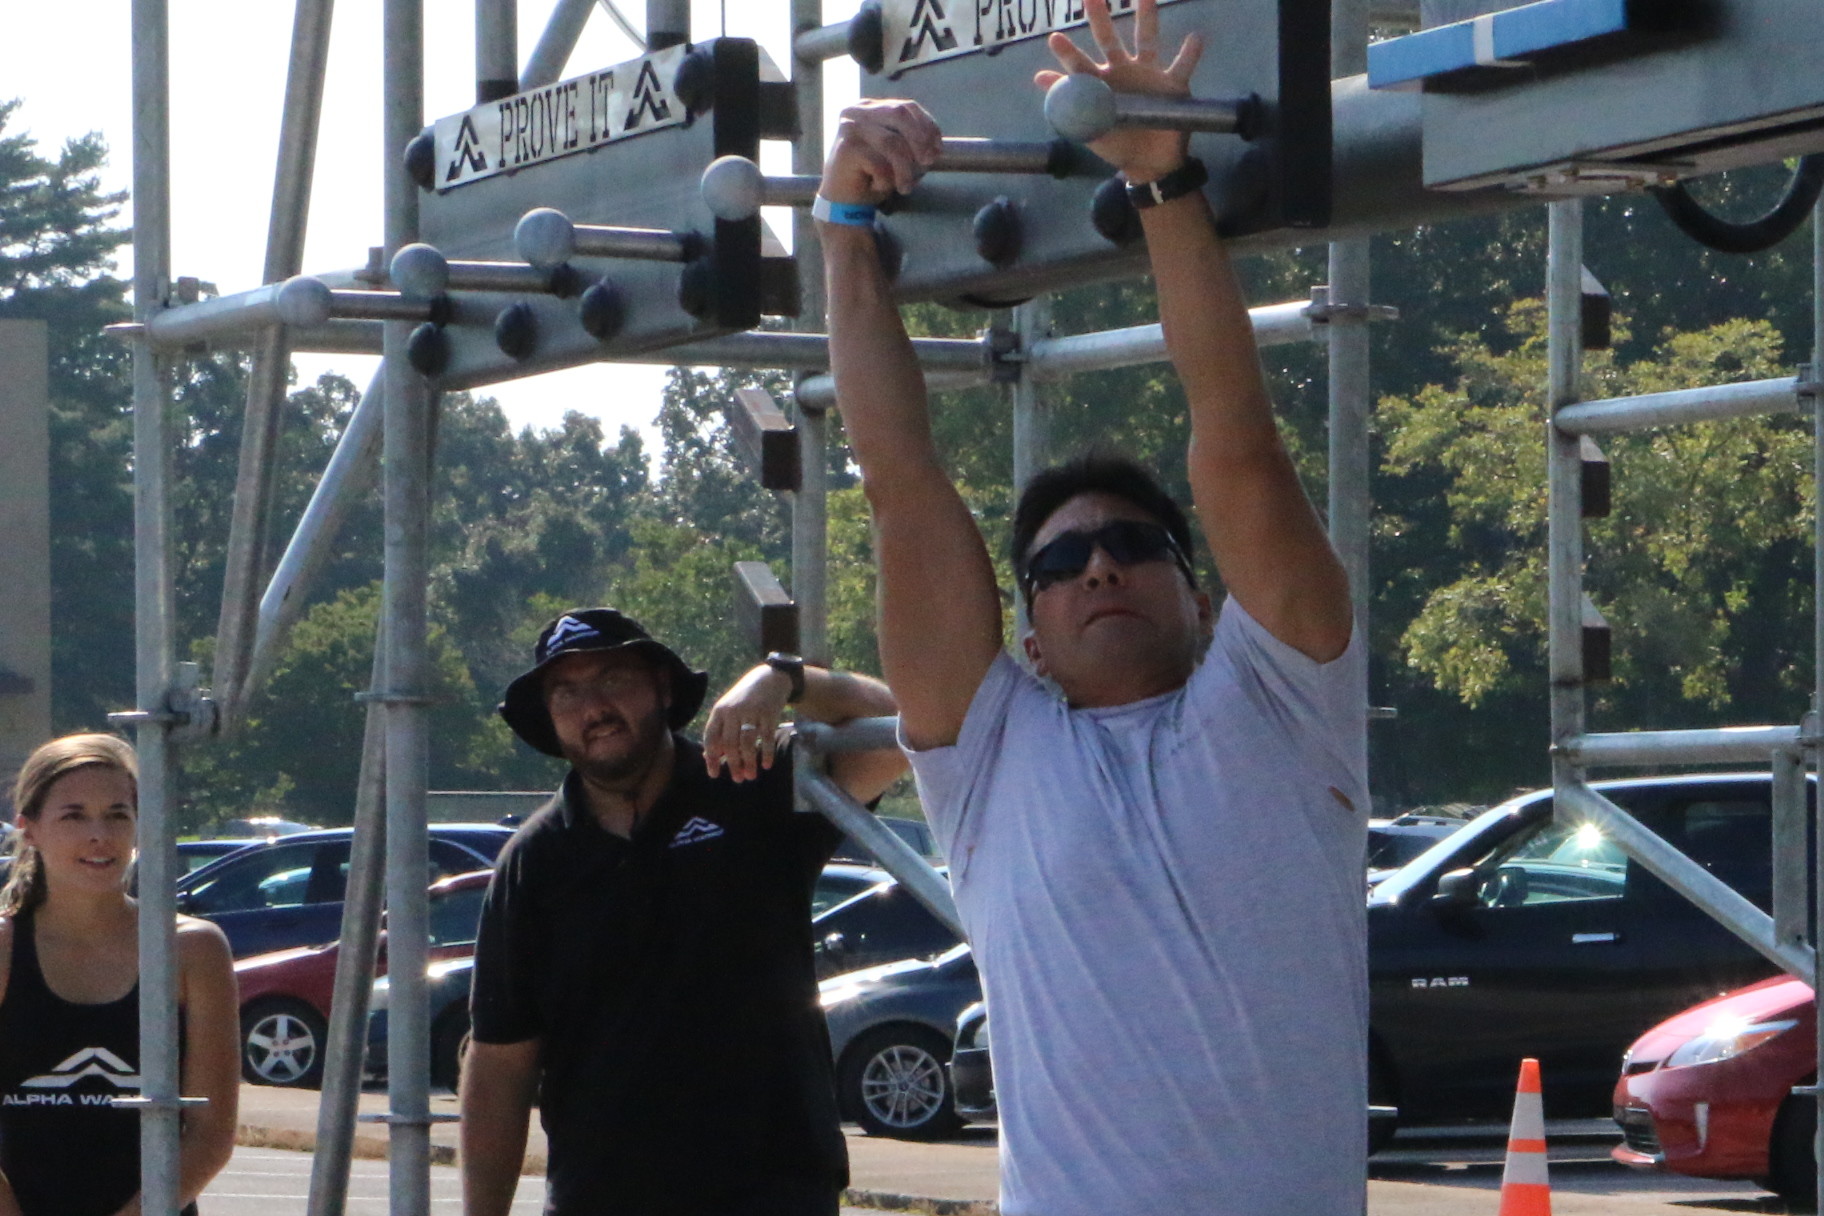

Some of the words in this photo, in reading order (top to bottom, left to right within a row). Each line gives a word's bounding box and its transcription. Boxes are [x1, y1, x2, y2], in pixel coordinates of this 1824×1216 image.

[499, 81, 578, 168] PROVE
[590, 70, 615, 143] IT
[1411, 976, 1469, 988] RAM
[2, 1093, 73, 1106] ALPHA
